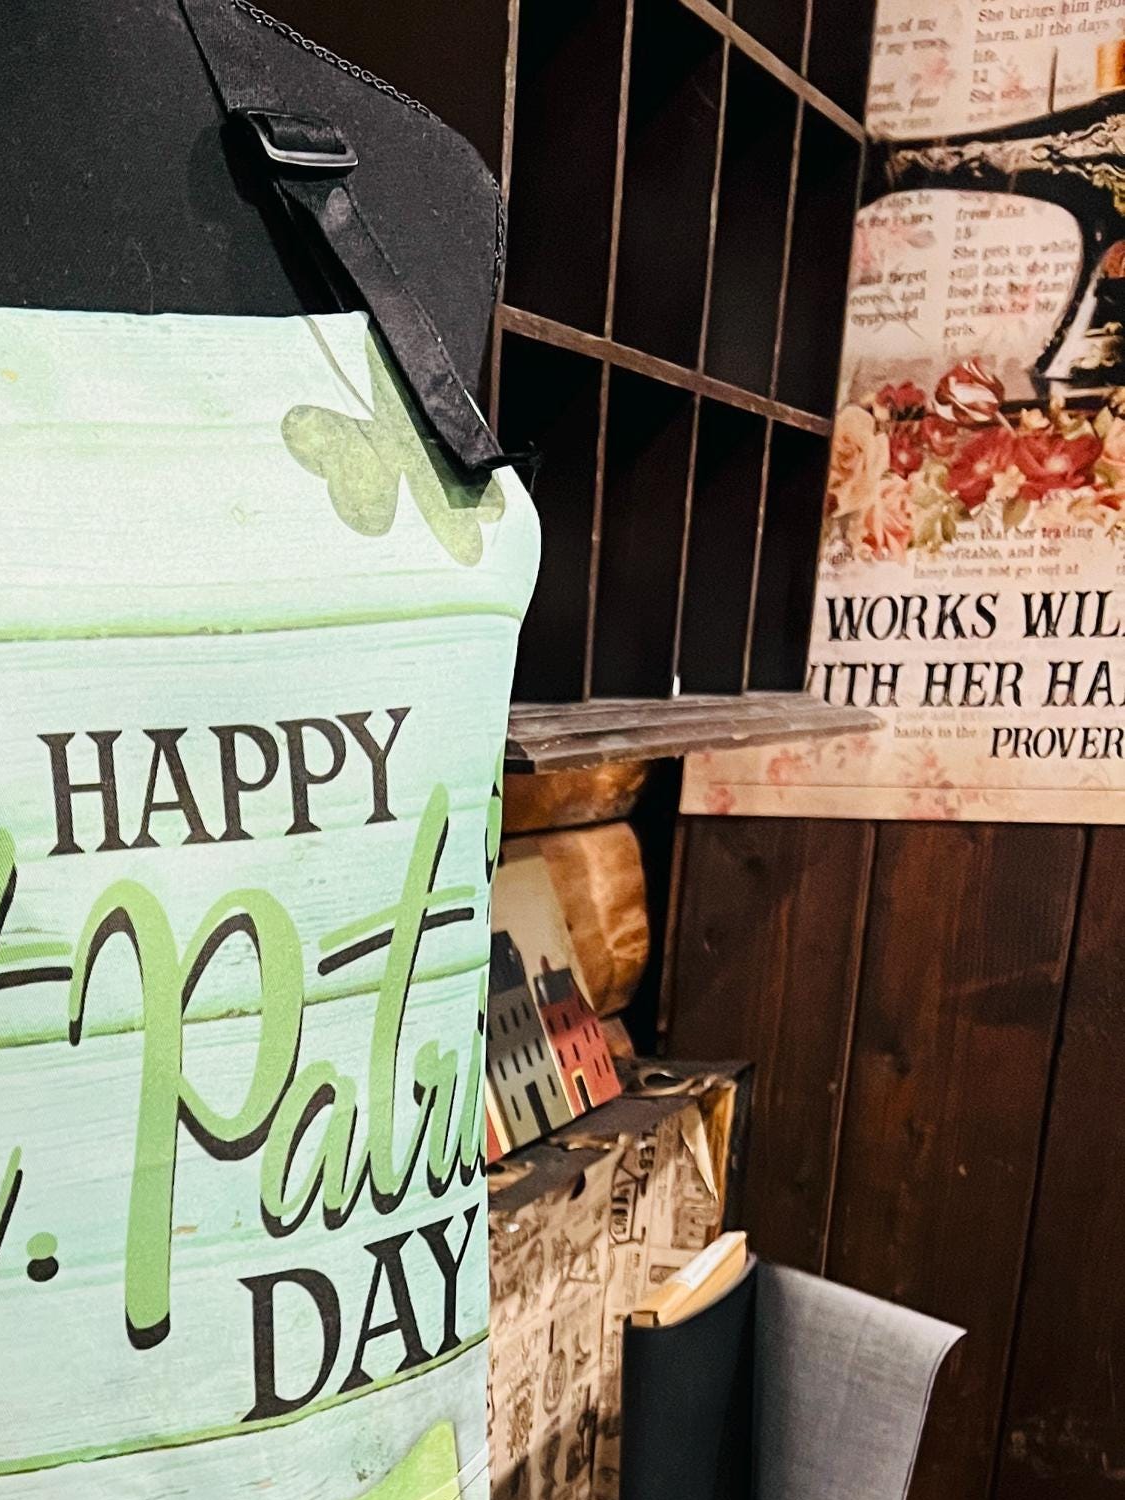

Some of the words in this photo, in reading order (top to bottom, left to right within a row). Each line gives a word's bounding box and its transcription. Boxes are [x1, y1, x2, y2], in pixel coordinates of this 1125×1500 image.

[978, 9, 1004, 22] She
[1094, 0, 1125, 14] goo
[1048, 21, 1072, 36] the
[1041, 526, 1094, 541] trading
[825, 592, 1001, 641] WORKS
[1020, 589, 1125, 639] WIL
[920, 660, 1025, 708] HER
[1041, 660, 1125, 708] HA
[37, 706, 412, 856] HAPPY
[68, 782, 489, 1351] Patri
[240, 1202, 480, 1424] DAY
